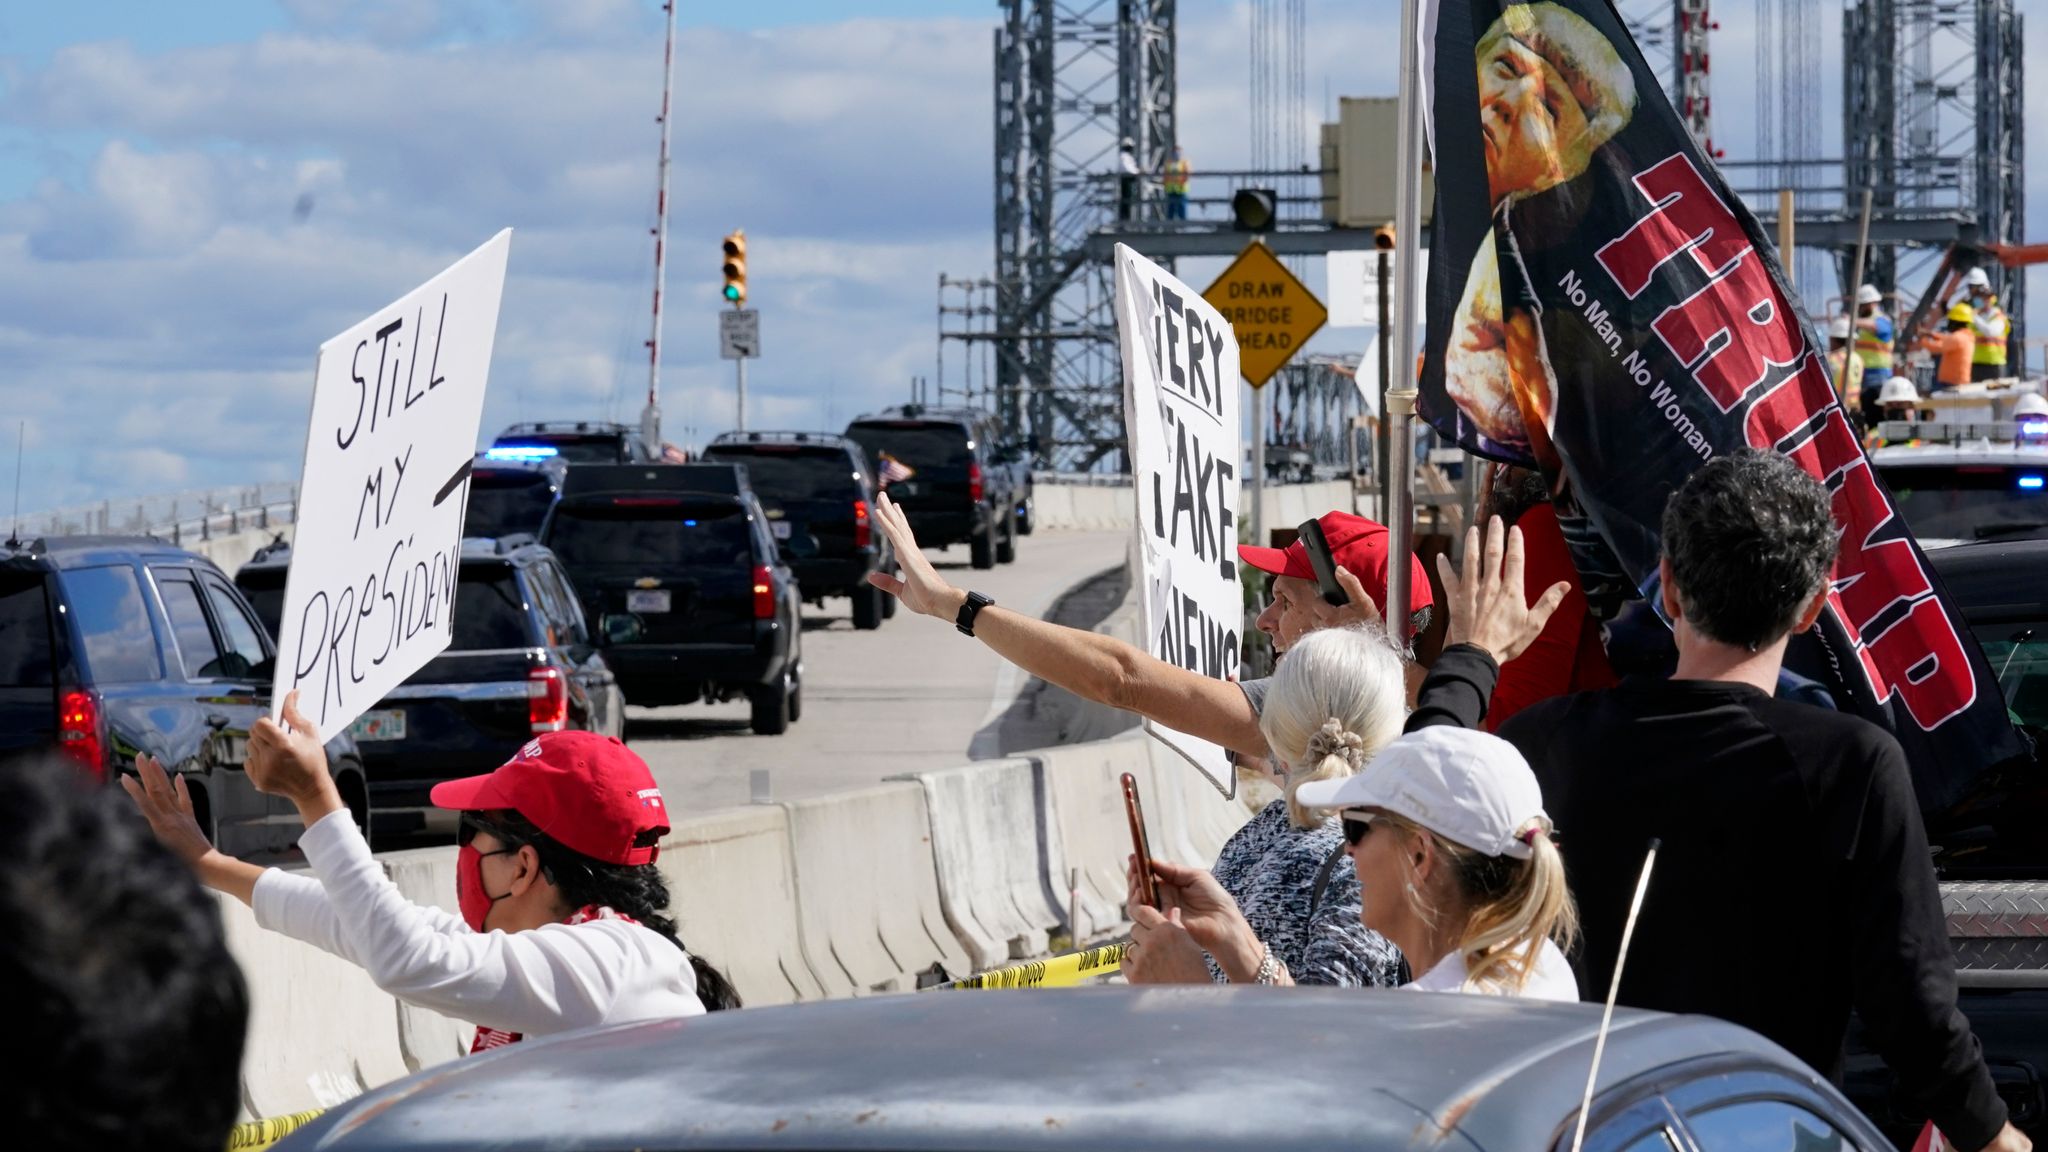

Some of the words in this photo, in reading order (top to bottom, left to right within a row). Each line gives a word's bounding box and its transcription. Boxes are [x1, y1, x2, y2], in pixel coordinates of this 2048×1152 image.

[1228, 281, 1285, 299] DRAW
[1557, 269, 1587, 306] No
[1583, 299, 1623, 358] Man,
[1621, 350, 1652, 386] No
[1238, 331, 1292, 350] HEAD
[1594, 151, 1977, 731] TRUMP
[353, 444, 413, 541] MY
